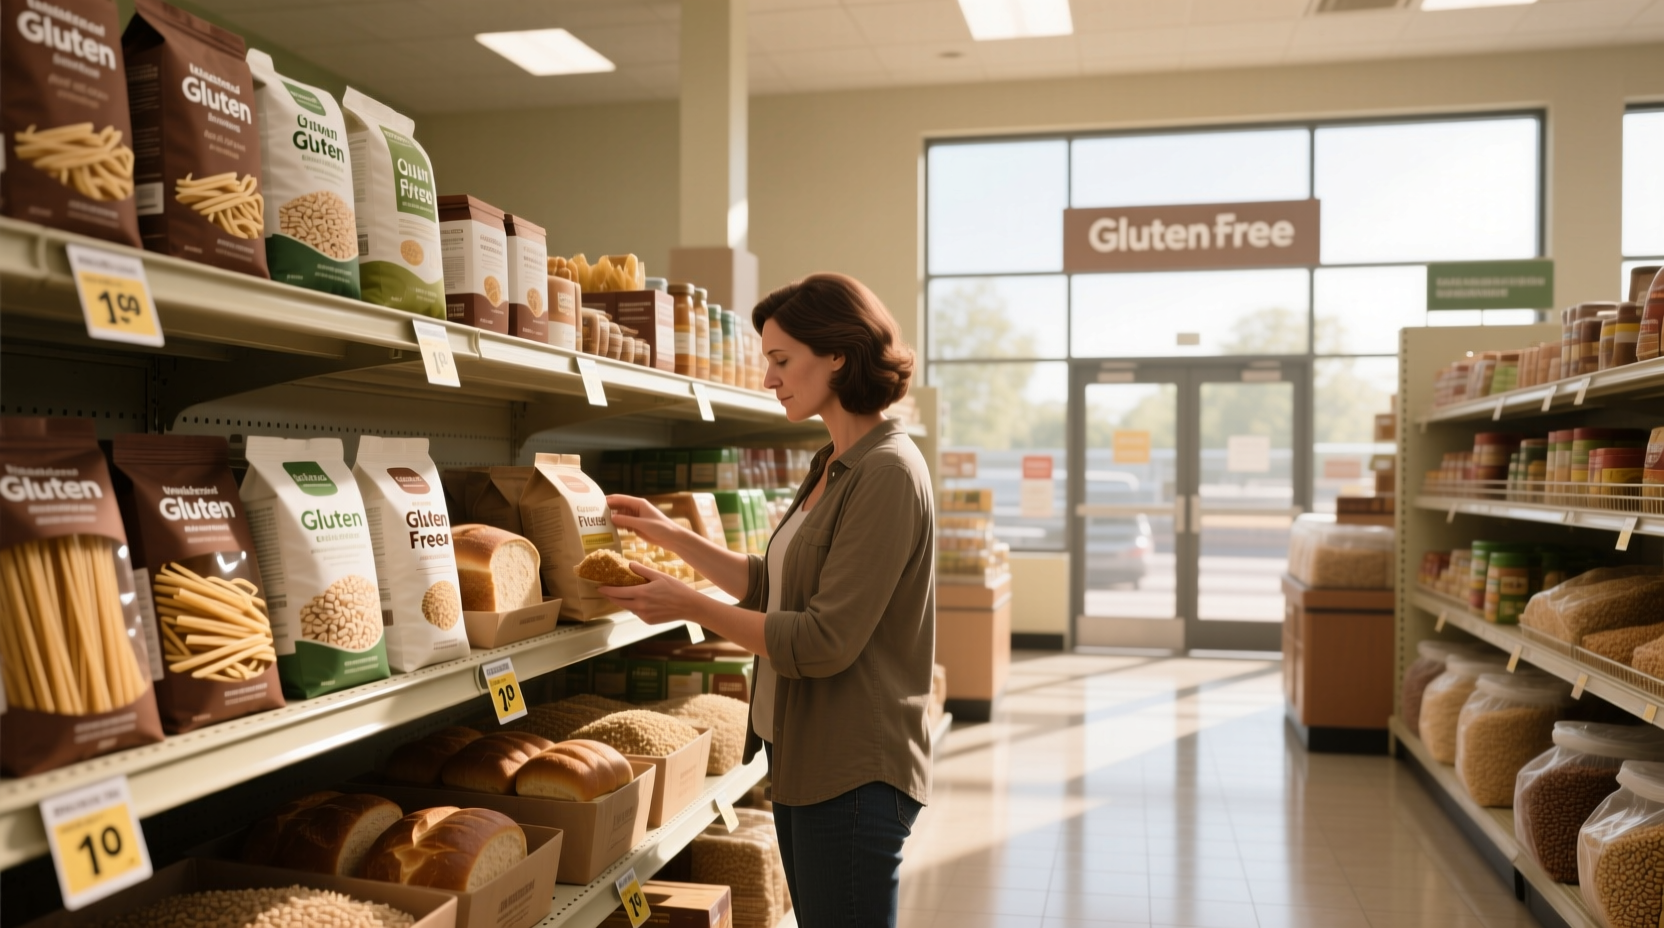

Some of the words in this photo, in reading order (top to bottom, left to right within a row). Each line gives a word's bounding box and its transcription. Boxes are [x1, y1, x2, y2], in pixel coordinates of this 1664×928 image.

[17, 10, 116, 71] Gluten
[182, 76, 252, 125] Gluten
[293, 130, 344, 163] Gluten
[1088, 216, 1210, 253] Gluten
[0, 475, 103, 502] Gluten
[159, 496, 236, 521] Gluten
[301, 509, 363, 531] Gluten
[406, 509, 448, 529] Gluten
[78, 825, 122, 876] 10
